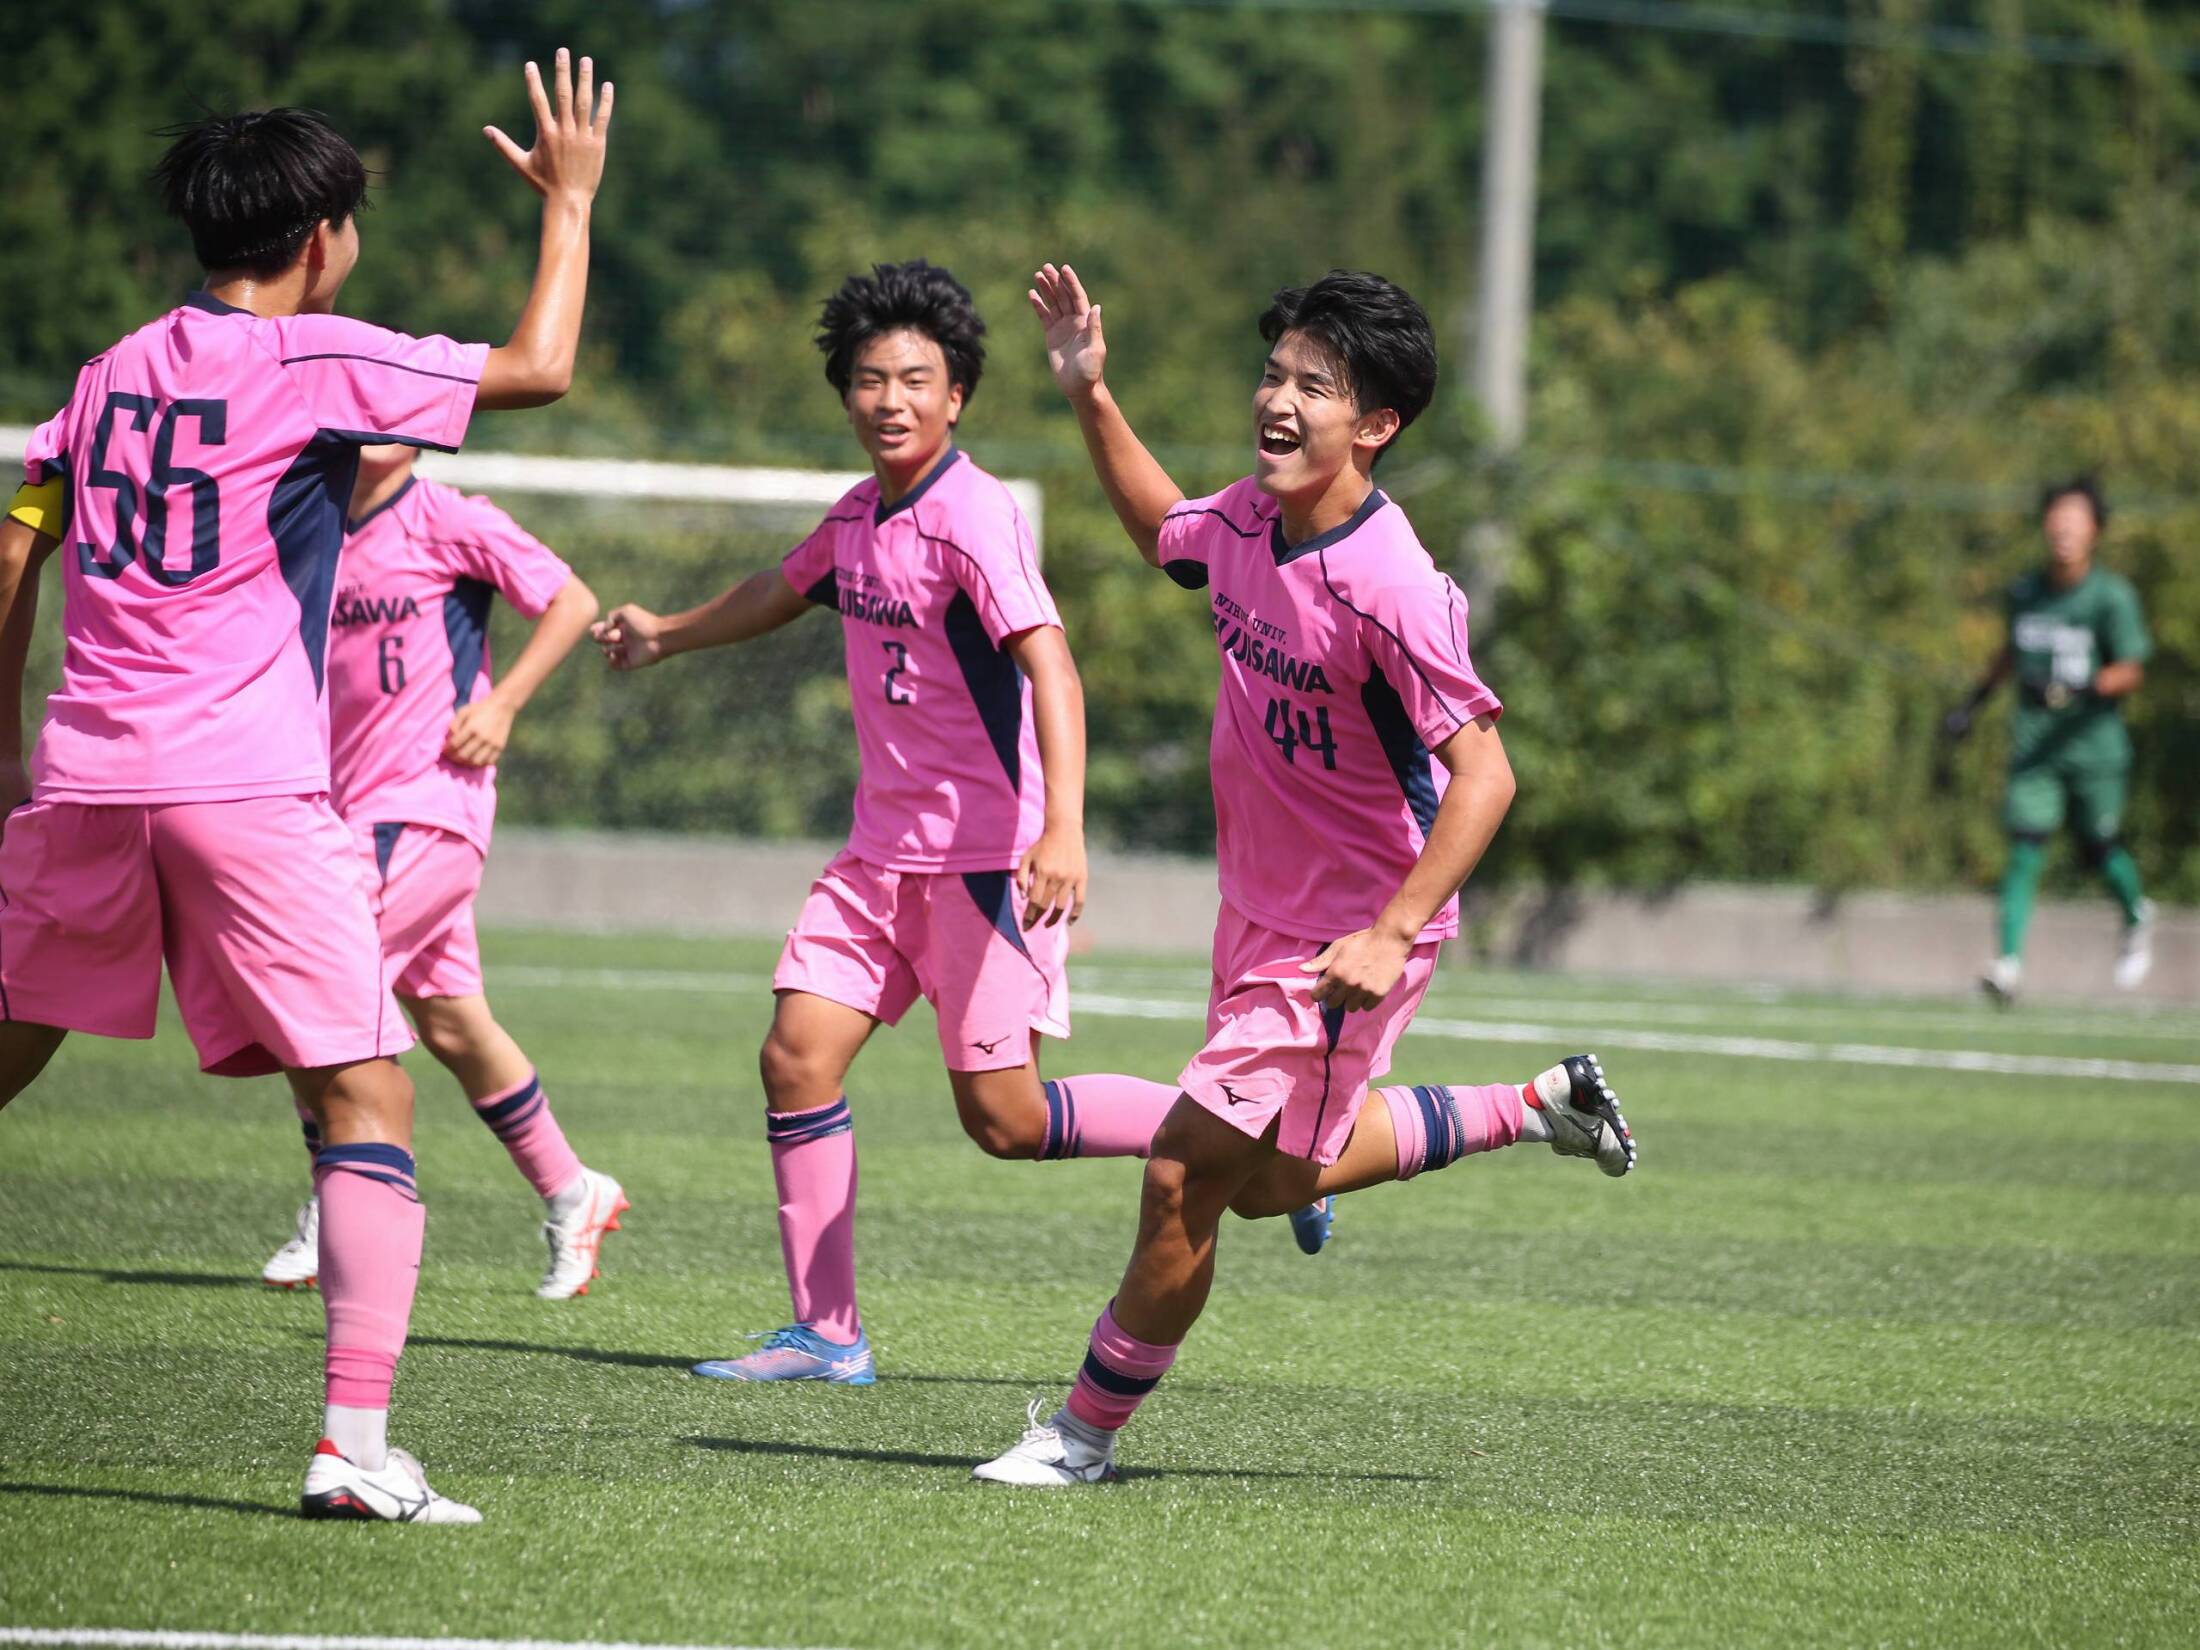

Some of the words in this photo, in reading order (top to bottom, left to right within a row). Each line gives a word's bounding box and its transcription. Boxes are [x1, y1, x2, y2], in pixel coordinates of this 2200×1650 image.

[77, 391, 227, 587] 56
[1253, 617, 1287, 645] UNIV.
[379, 636, 406, 695] 6
[882, 641, 910, 705] 2
[1265, 698, 1338, 771] 44
